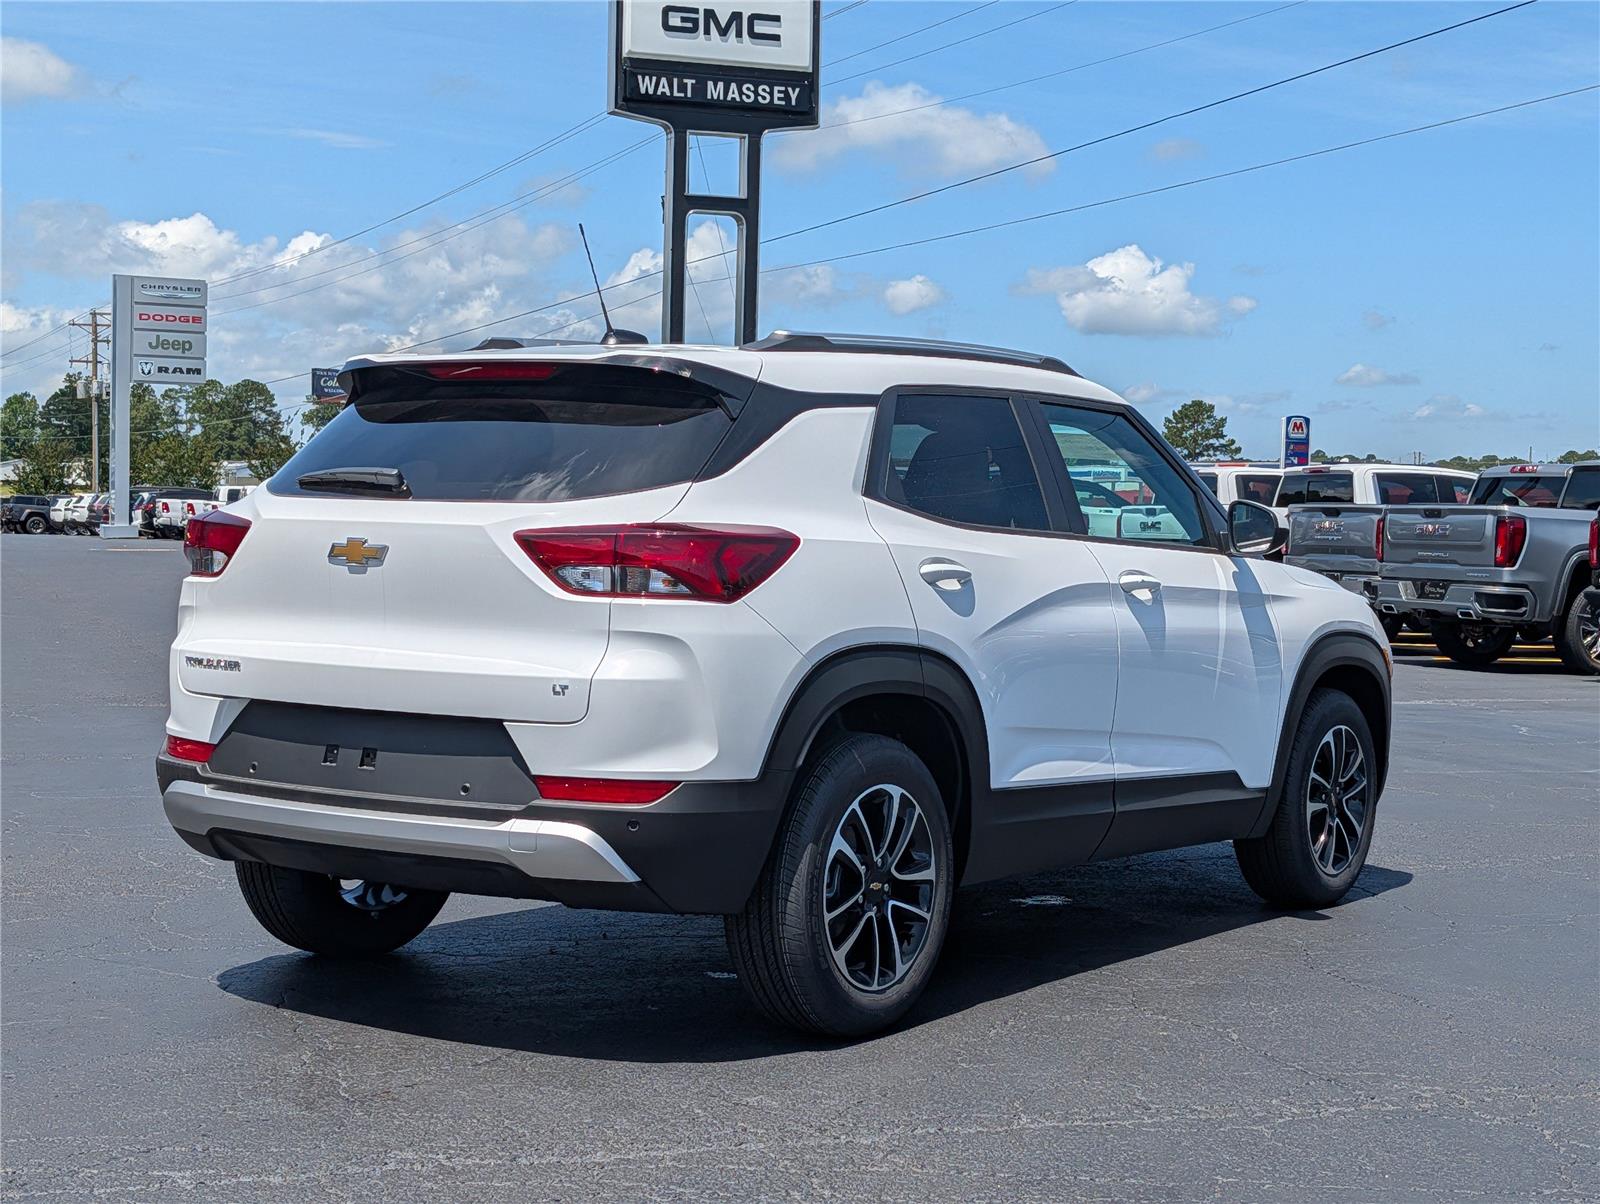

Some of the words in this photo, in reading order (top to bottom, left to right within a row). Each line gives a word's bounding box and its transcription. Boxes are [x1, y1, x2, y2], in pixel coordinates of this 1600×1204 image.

[661, 5, 782, 44] GMC
[637, 75, 696, 98] WALT
[706, 80, 800, 106] MASSEY
[141, 283, 201, 293] CHRYSLER
[139, 313, 203, 324] DODGE
[148, 334, 193, 354] Jeep
[157, 366, 202, 376] RAM
[552, 683, 569, 697] LT
